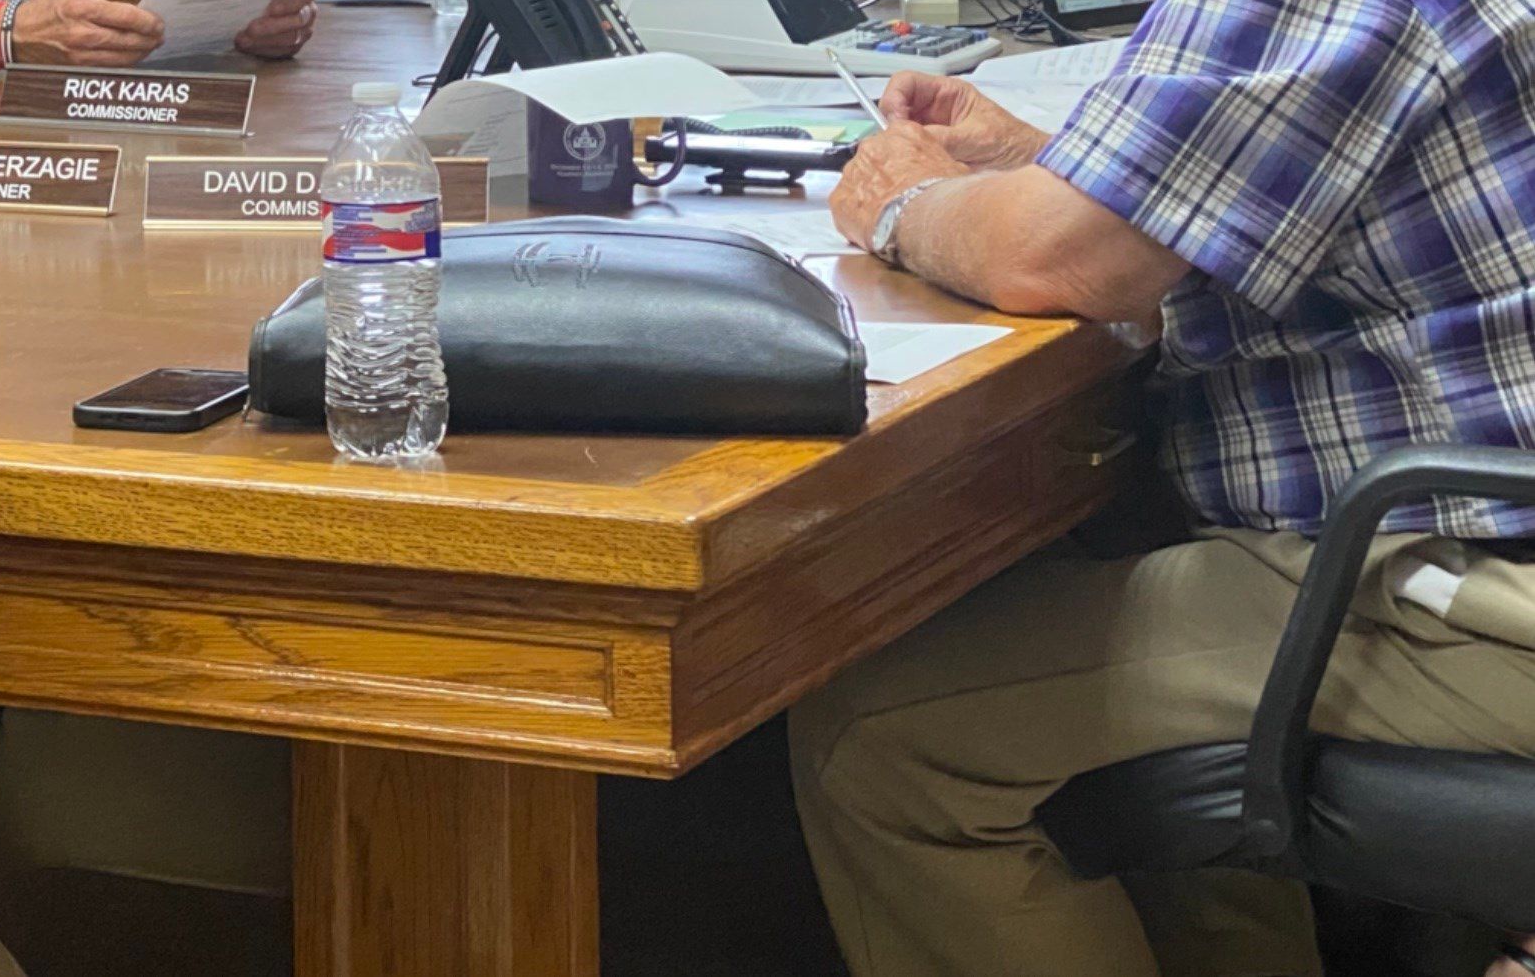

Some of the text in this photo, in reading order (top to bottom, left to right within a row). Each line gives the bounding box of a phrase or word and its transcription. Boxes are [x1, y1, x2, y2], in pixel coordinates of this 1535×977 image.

[63, 78, 191, 104] RICK KARAS
[67, 103, 178, 122] COMMISSIONER
[203, 171, 287, 194] DAVID
[296, 171, 322, 195] D.
[241, 199, 321, 217] COMMIS
